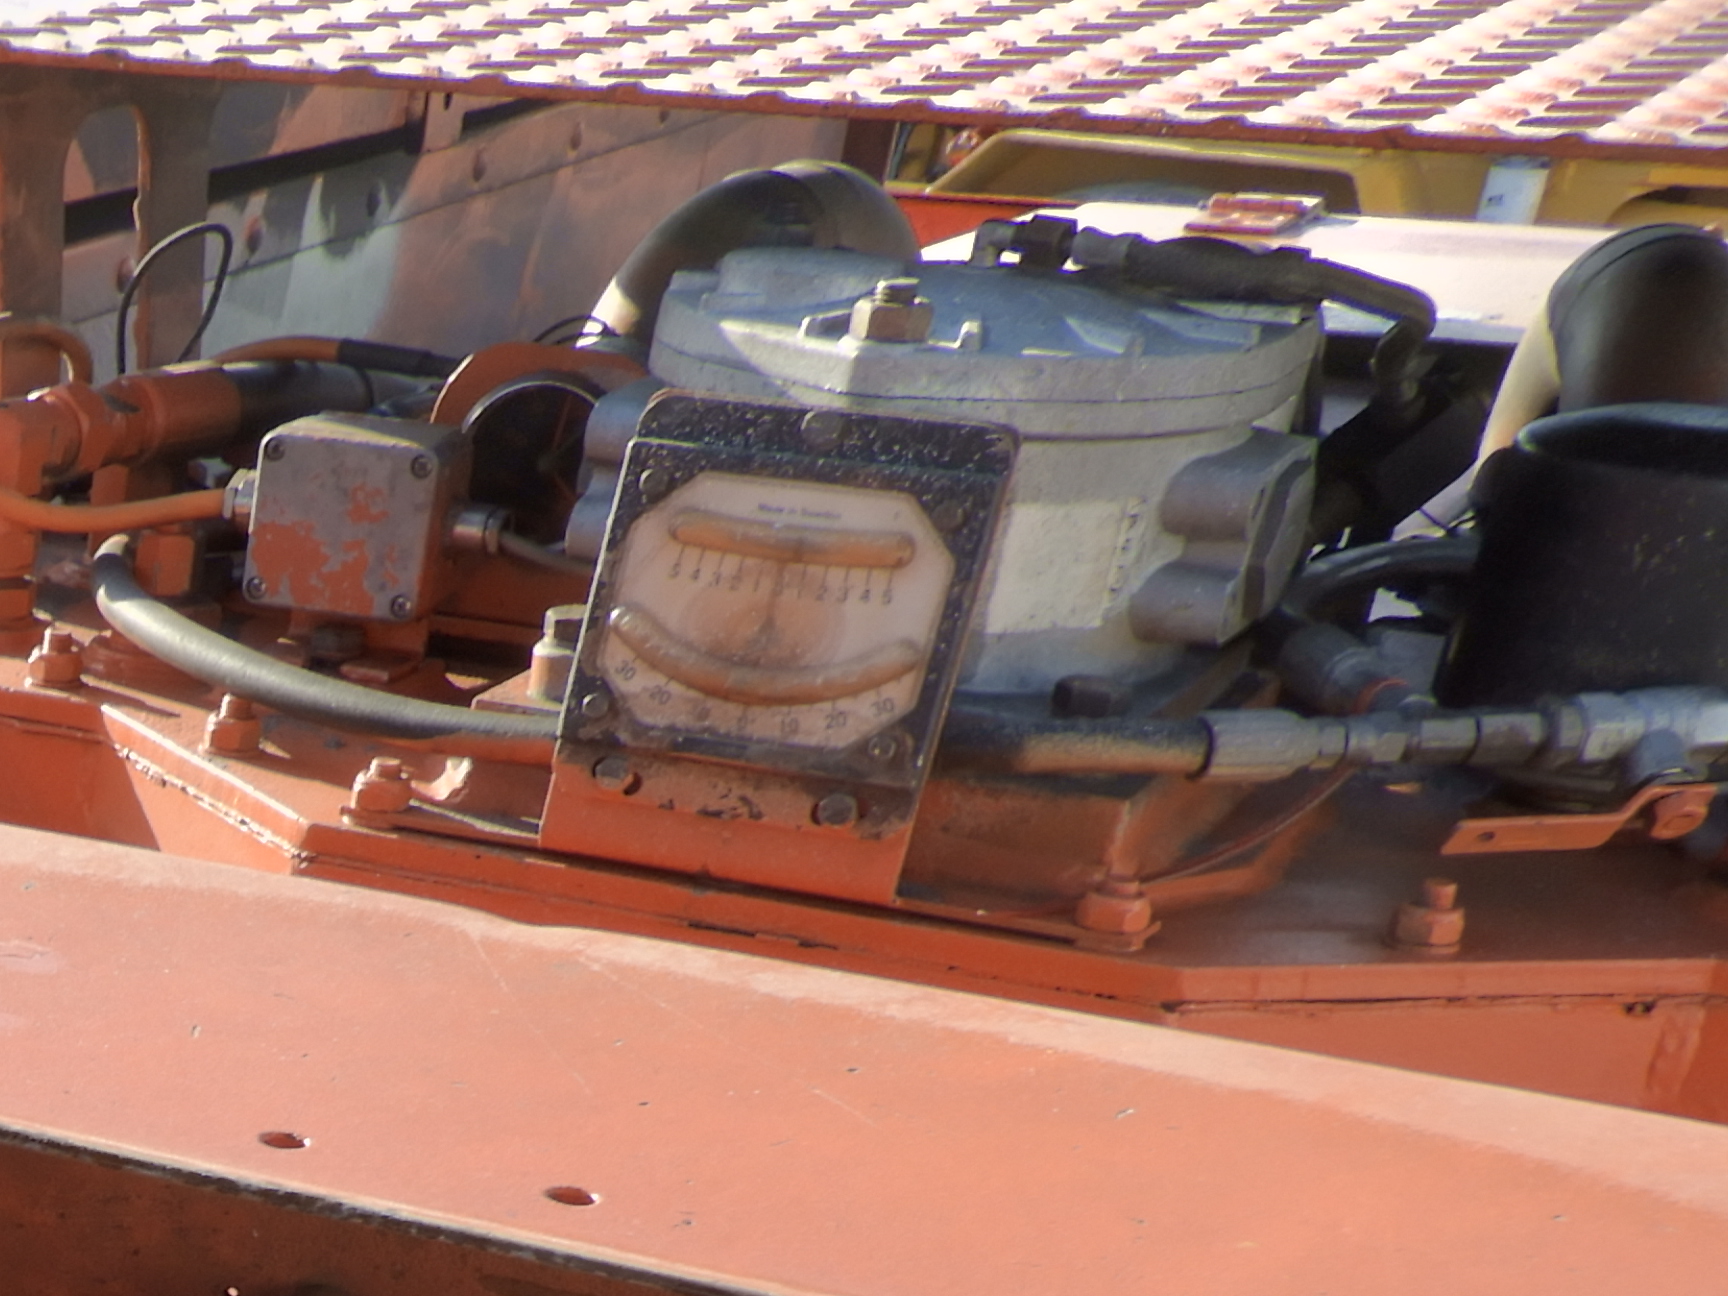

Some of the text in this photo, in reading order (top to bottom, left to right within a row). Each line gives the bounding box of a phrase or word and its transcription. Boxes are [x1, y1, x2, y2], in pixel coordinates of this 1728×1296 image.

[615, 658, 636, 680] 30
[648, 685, 670, 705] 20
[871, 698, 894, 718] 30
[824, 712, 846, 730] 20
